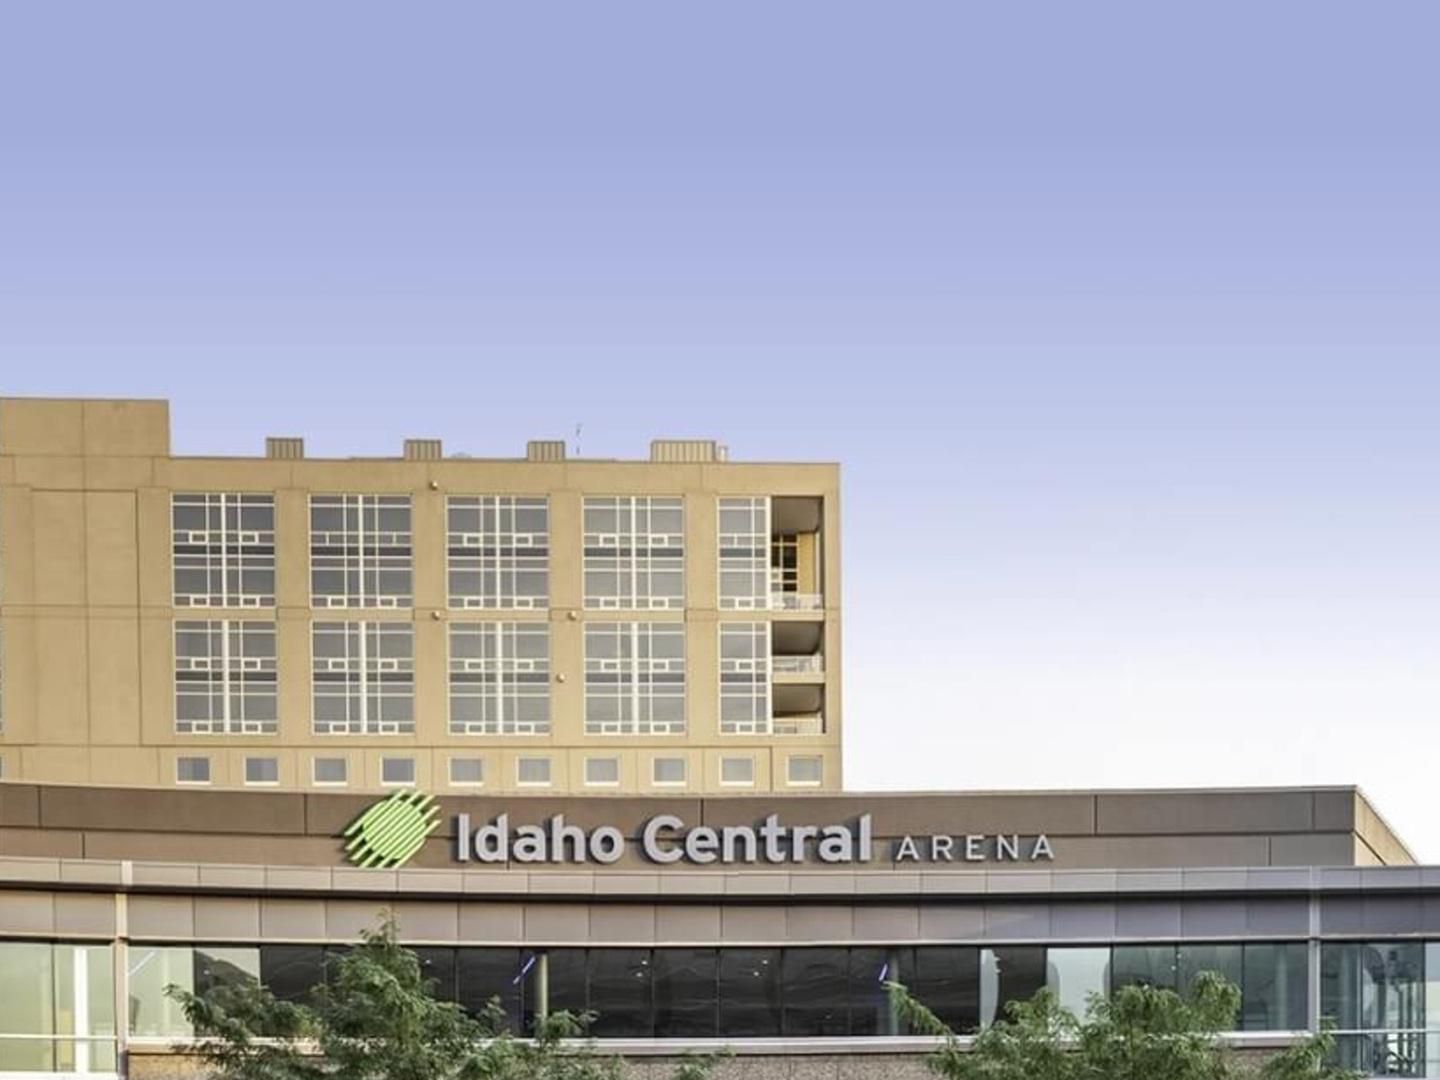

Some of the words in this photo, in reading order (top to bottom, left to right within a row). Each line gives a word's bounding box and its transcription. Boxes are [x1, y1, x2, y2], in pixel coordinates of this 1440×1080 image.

[457, 812, 625, 864] Idaho
[643, 812, 872, 863] Central
[895, 833, 1055, 861] ARENA
